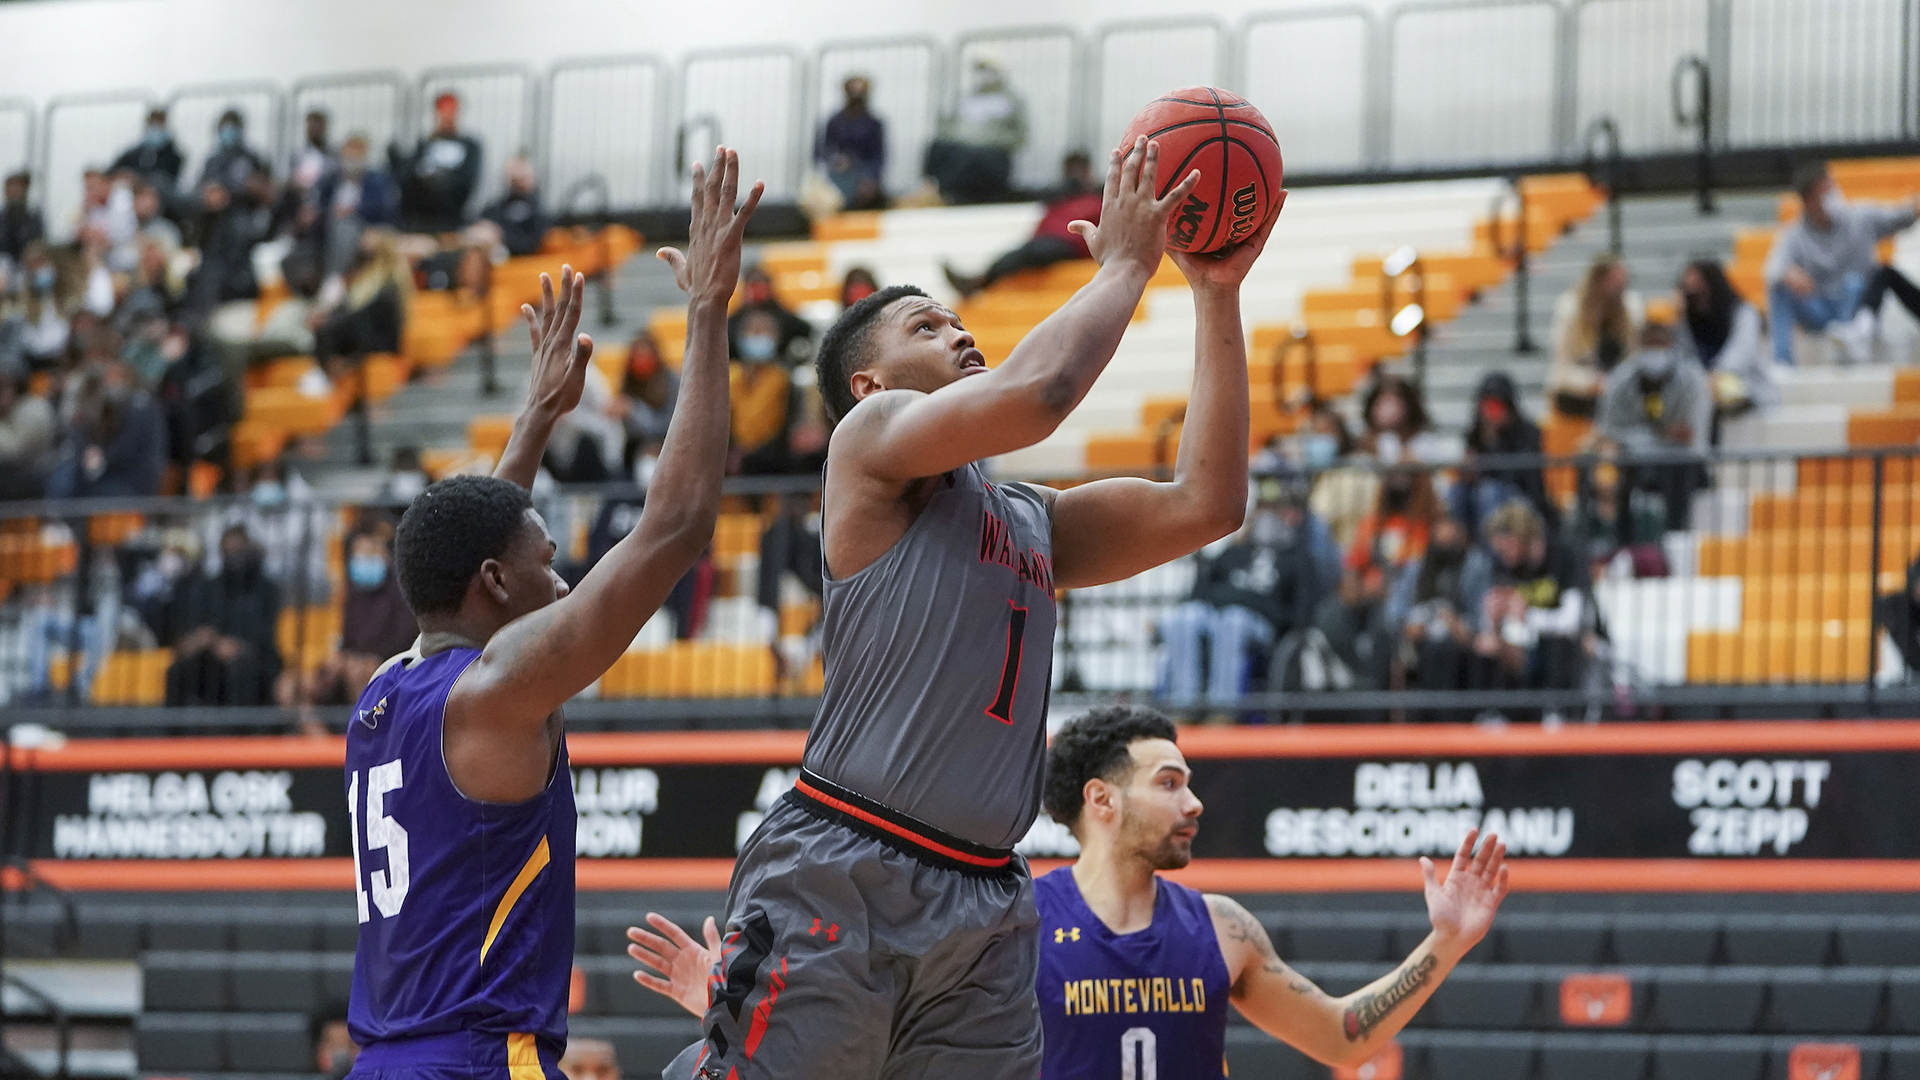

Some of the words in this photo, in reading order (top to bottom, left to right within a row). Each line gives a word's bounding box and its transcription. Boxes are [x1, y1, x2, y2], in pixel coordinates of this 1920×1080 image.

[984, 599, 1028, 726] 1
[88, 772, 209, 815] HELGA
[211, 771, 293, 814] OSK
[1354, 761, 1485, 808] DELIA
[1672, 759, 1831, 809] SCOTT
[348, 758, 409, 924] 15
[1687, 807, 1809, 856] ZEPP
[1064, 977, 1206, 1015] MONTEVALLO
